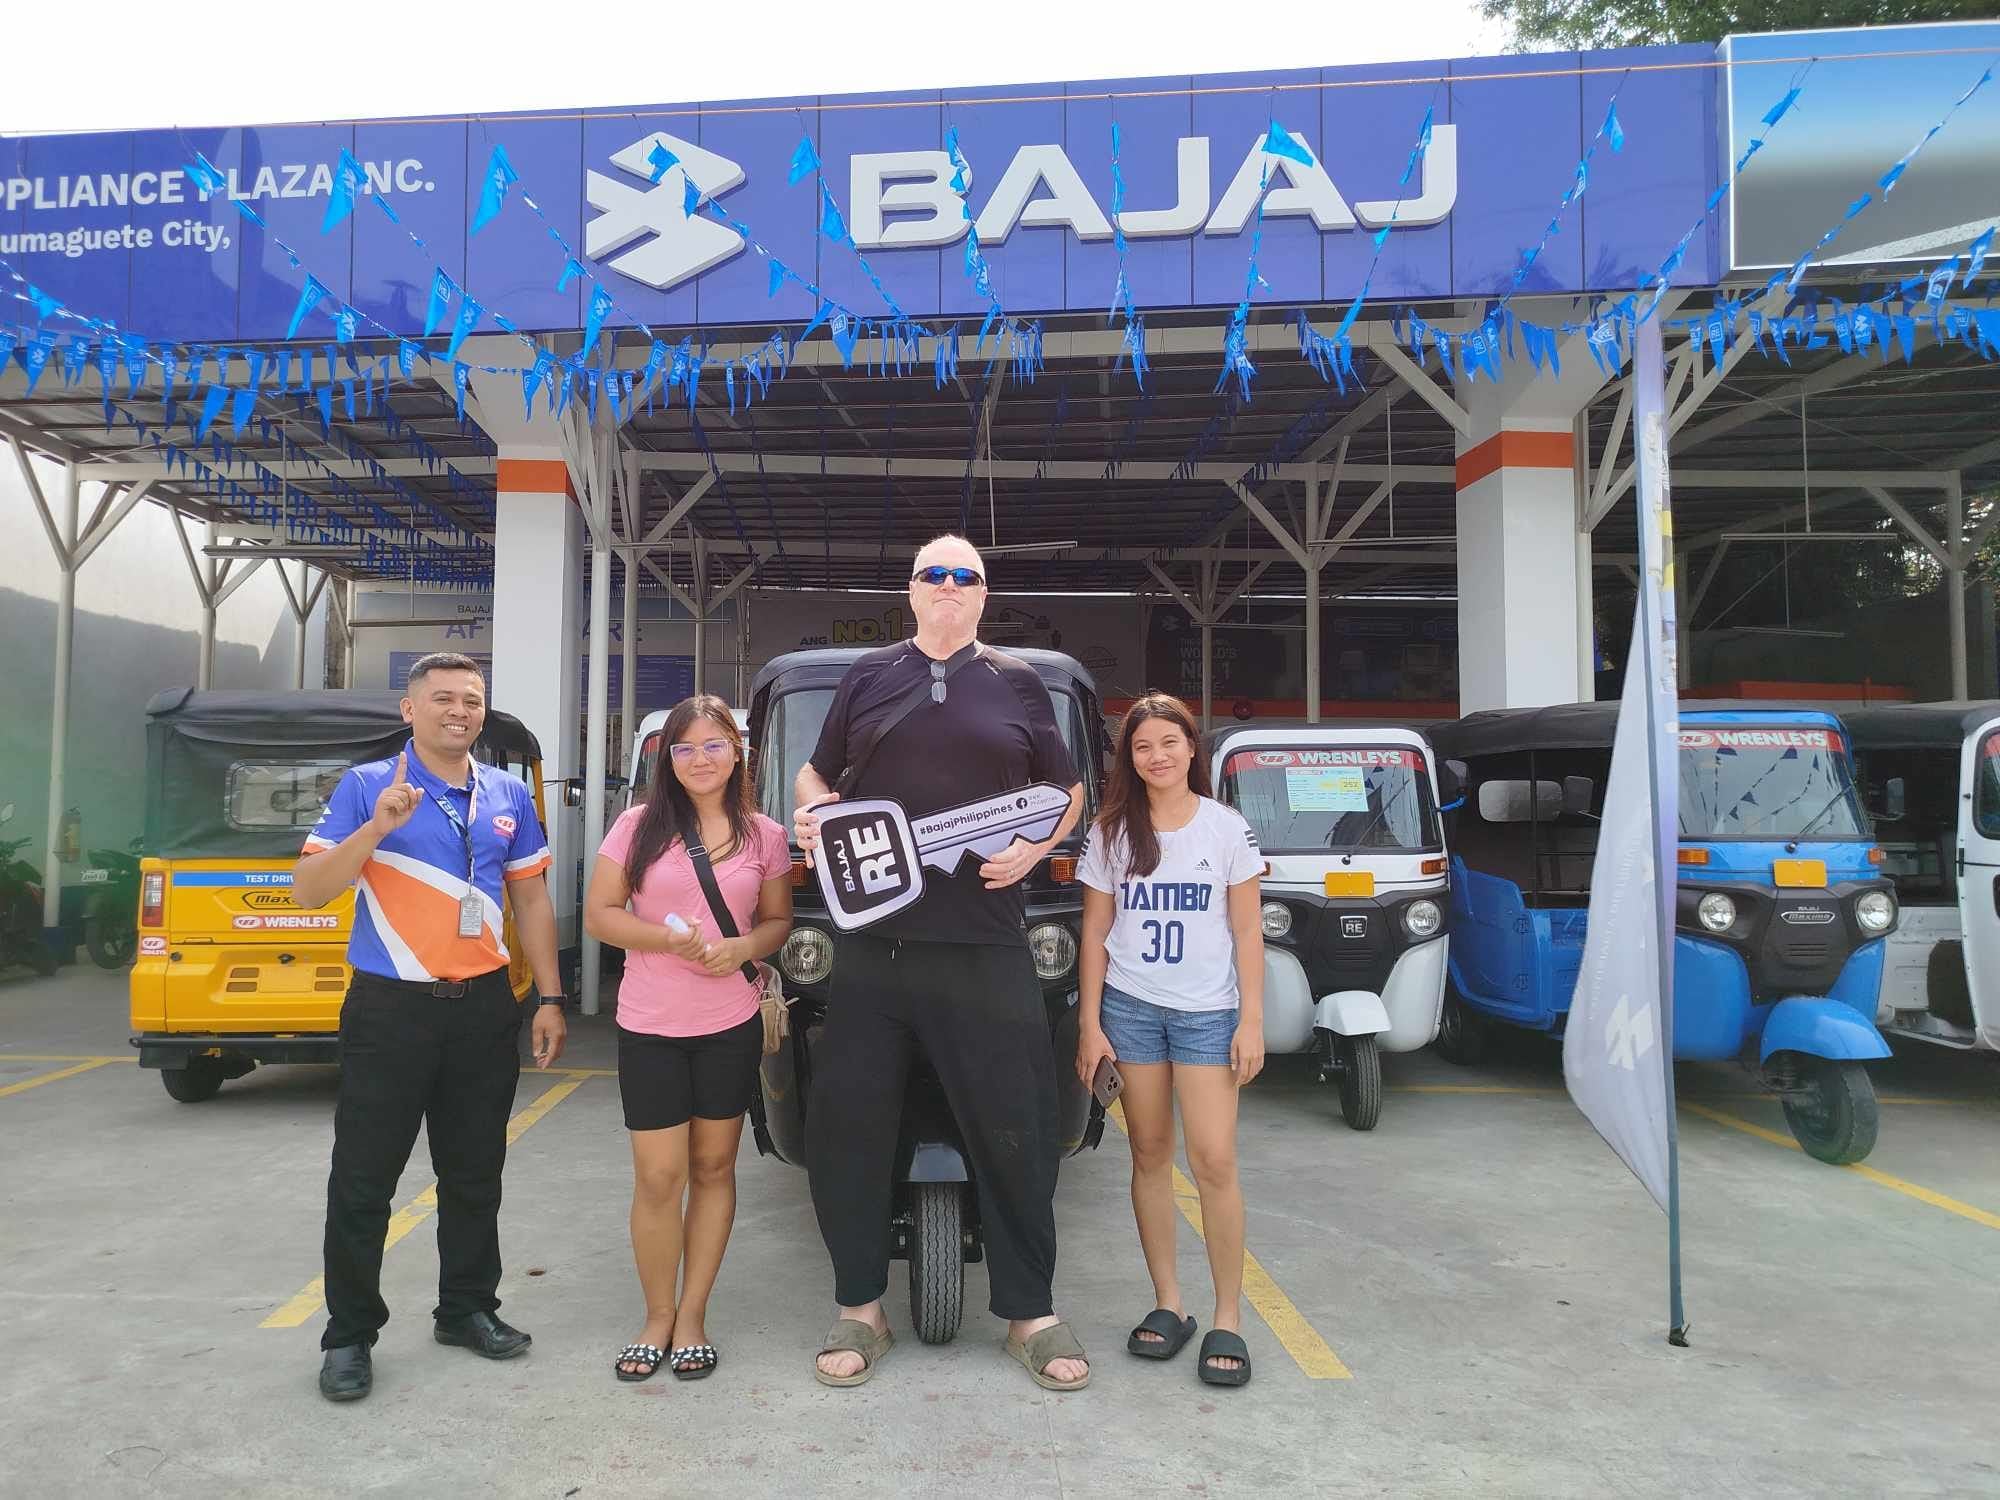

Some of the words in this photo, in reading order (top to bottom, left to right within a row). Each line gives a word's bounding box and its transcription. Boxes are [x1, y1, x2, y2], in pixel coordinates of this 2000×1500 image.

[0, 170, 184, 211] PLIANCE
[199, 163, 334, 202] LAZA
[360, 159, 435, 195] NC.
[850, 124, 1457, 249] BAJAJ
[162, 220, 231, 253] City,
[832, 608, 903, 643] NO.1
[1716, 732, 1827, 747] WRENLEYS
[1298, 751, 1401, 765] WRENLEYS
[919, 803, 1013, 835] #BajajPhilippines
[834, 839, 856, 892] BAJAJ
[848, 820, 902, 895] RE
[245, 874, 269, 883] TEST
[264, 916, 338, 928] WRENLEYS
[1345, 923, 1363, 933] RE
[1141, 919, 1184, 964] 30
